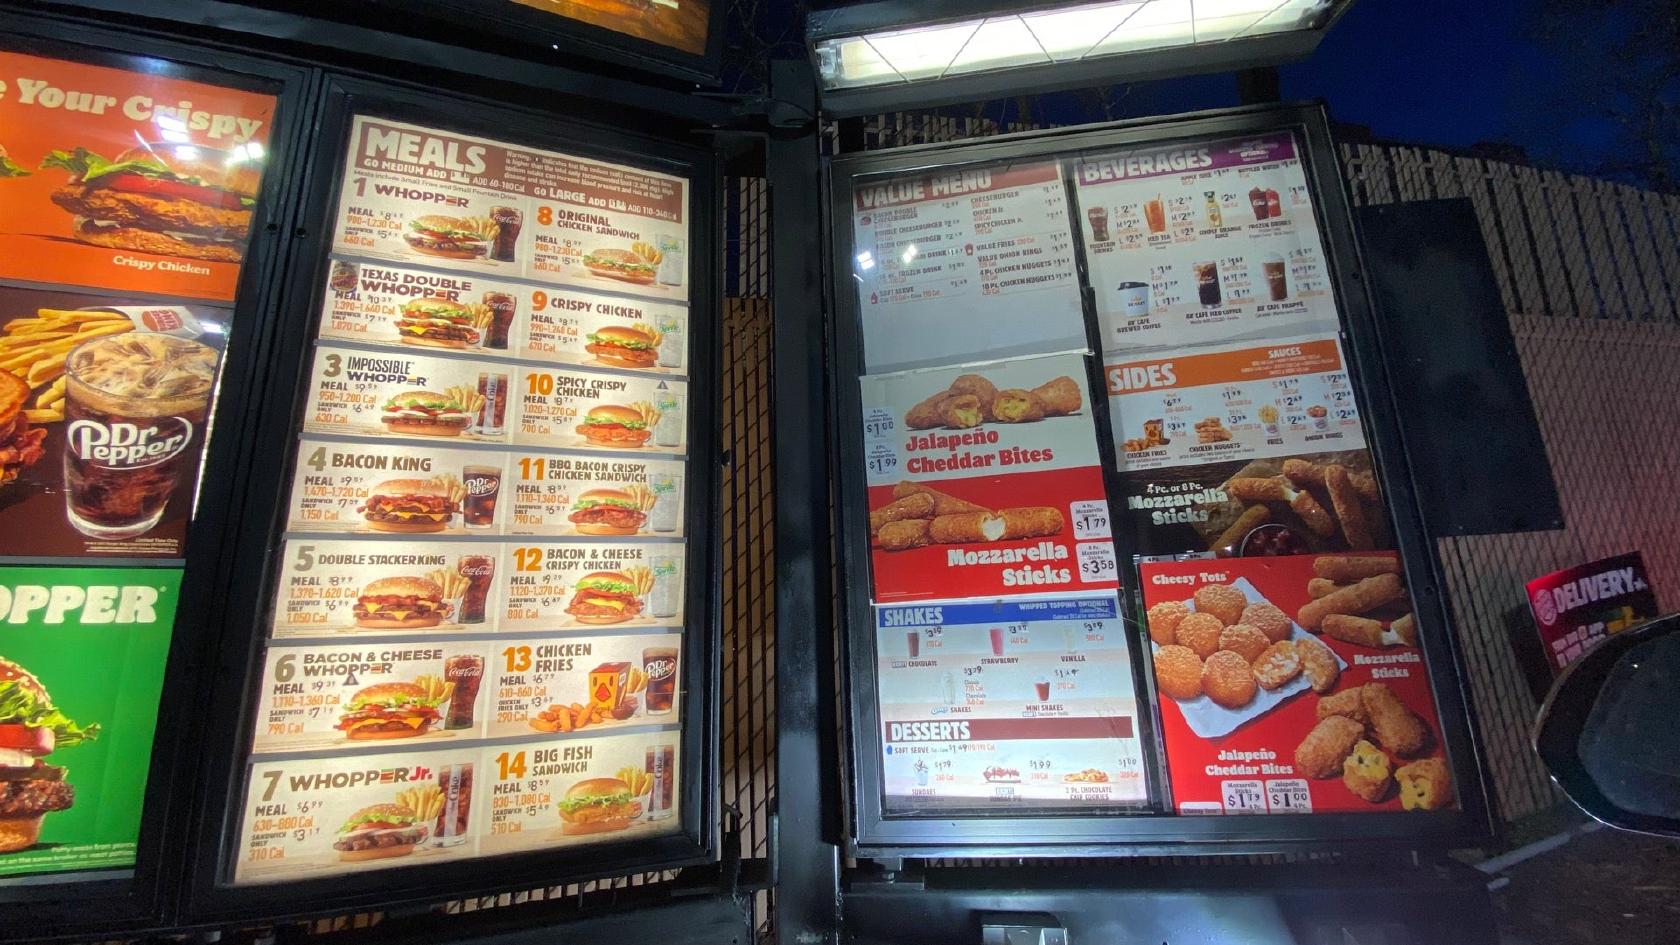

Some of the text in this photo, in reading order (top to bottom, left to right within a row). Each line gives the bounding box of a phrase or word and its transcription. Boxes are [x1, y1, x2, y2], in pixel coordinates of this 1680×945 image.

[16, 78, 117, 116] Your
[366, 127, 487, 174] MEALS
[364, 158, 379, 169] GO
[387, 161, 424, 175] MEDIUM
[426, 167, 447, 179] ADD
[1083, 148, 1213, 181] BEVERAGES
[353, 177, 470, 209] 1 WHOPPER
[549, 187, 586, 204] LARGE
[588, 196, 607, 208] ADD
[861, 168, 993, 209] VALUE MENU
[348, 206, 374, 218] MEAL
[537, 205, 553, 226] 8
[558, 208, 610, 227] ORIGINAL
[536, 235, 558, 245] MEAL
[557, 219, 641, 241] CHICKEN SANDWICH
[112, 254, 211, 276] Crispy Chicken
[361, 268, 472, 292] TEXAS DOUBLE
[361, 279, 460, 302] WHOPPER
[335, 291, 361, 302] MEAL
[531, 290, 548, 312] 9
[550, 297, 593, 313] CRISPY
[596, 303, 643, 320] CHICKEN
[531, 314, 555, 324] MEAL
[1268, 346, 1302, 359] SAUCES
[322, 353, 411, 378] 3 IMPOSSIBLE
[321, 380, 348, 391] MEAL
[346, 370, 427, 387] WHOPPER
[525, 373, 627, 396] 10 SPICY CRISPY
[1108, 363, 1177, 392] SIDES
[523, 394, 548, 405] MEAL
[555, 386, 601, 399] CHICKEN
[67, 419, 184, 466] Pepper
[109, 423, 158, 447] Dr
[905, 427, 999, 453] Jalapeño
[307, 446, 432, 472] 4 BACON KING
[518, 457, 647, 481] 11 BBQ BACON CRISPY
[906, 452, 997, 474] Cheddar
[998, 446, 1054, 466] Bites
[304, 475, 334, 487] MEAL
[547, 469, 648, 483] CHICKEN SANDWICH
[516, 484, 542, 494] MEAL
[1154, 484, 1169, 494] Pc.
[1170, 484, 1181, 493] or
[1181, 482, 1189, 491] 8
[1189, 481, 1204, 491] Pc.
[1127, 488, 1229, 511] Mozzarella
[1151, 507, 1209, 526] Sticks
[293, 545, 446, 572] 5 DOUBLE STACKER KING
[512, 547, 642, 572] 12 BACON & CHEESE
[946, 541, 1069, 567] Mozzarella
[545, 560, 622, 571] CRISPY CHICKEN
[1002, 564, 1072, 587] Sticks
[290, 575, 321, 587] MEAL
[510, 575, 536, 585] MEAL
[1151, 570, 1227, 587] Cheesy Tots
[1552, 566, 1635, 614] DELIVERY
[1018, 600, 1048, 611] WHIPPED
[1049, 599, 1077, 610] TOPPING
[884, 606, 943, 626] SHAKES
[274, 648, 443, 682] 6 BACON & CHEESE
[501, 643, 592, 673] 13 CHICKEN
[535, 658, 574, 674] FRIES
[1353, 652, 1421, 667] Mozzarella
[303, 662, 393, 678] WHOPPER
[1371, 666, 1410, 680] Sticks
[273, 683, 305, 695] MEAL
[499, 675, 527, 687] MEAL
[890, 721, 970, 742] DESSERTS
[495, 745, 593, 781] 14 BIG FISH
[1216, 747, 1277, 763] Jalapeño
[532, 761, 588, 777] SANDWICH
[1204, 762, 1294, 777] Cheddar Bites
[261, 765, 433, 802] 7 WHOPPER Jr.
[493, 782, 522, 796] MEAL
[254, 803, 288, 817] MEAL
